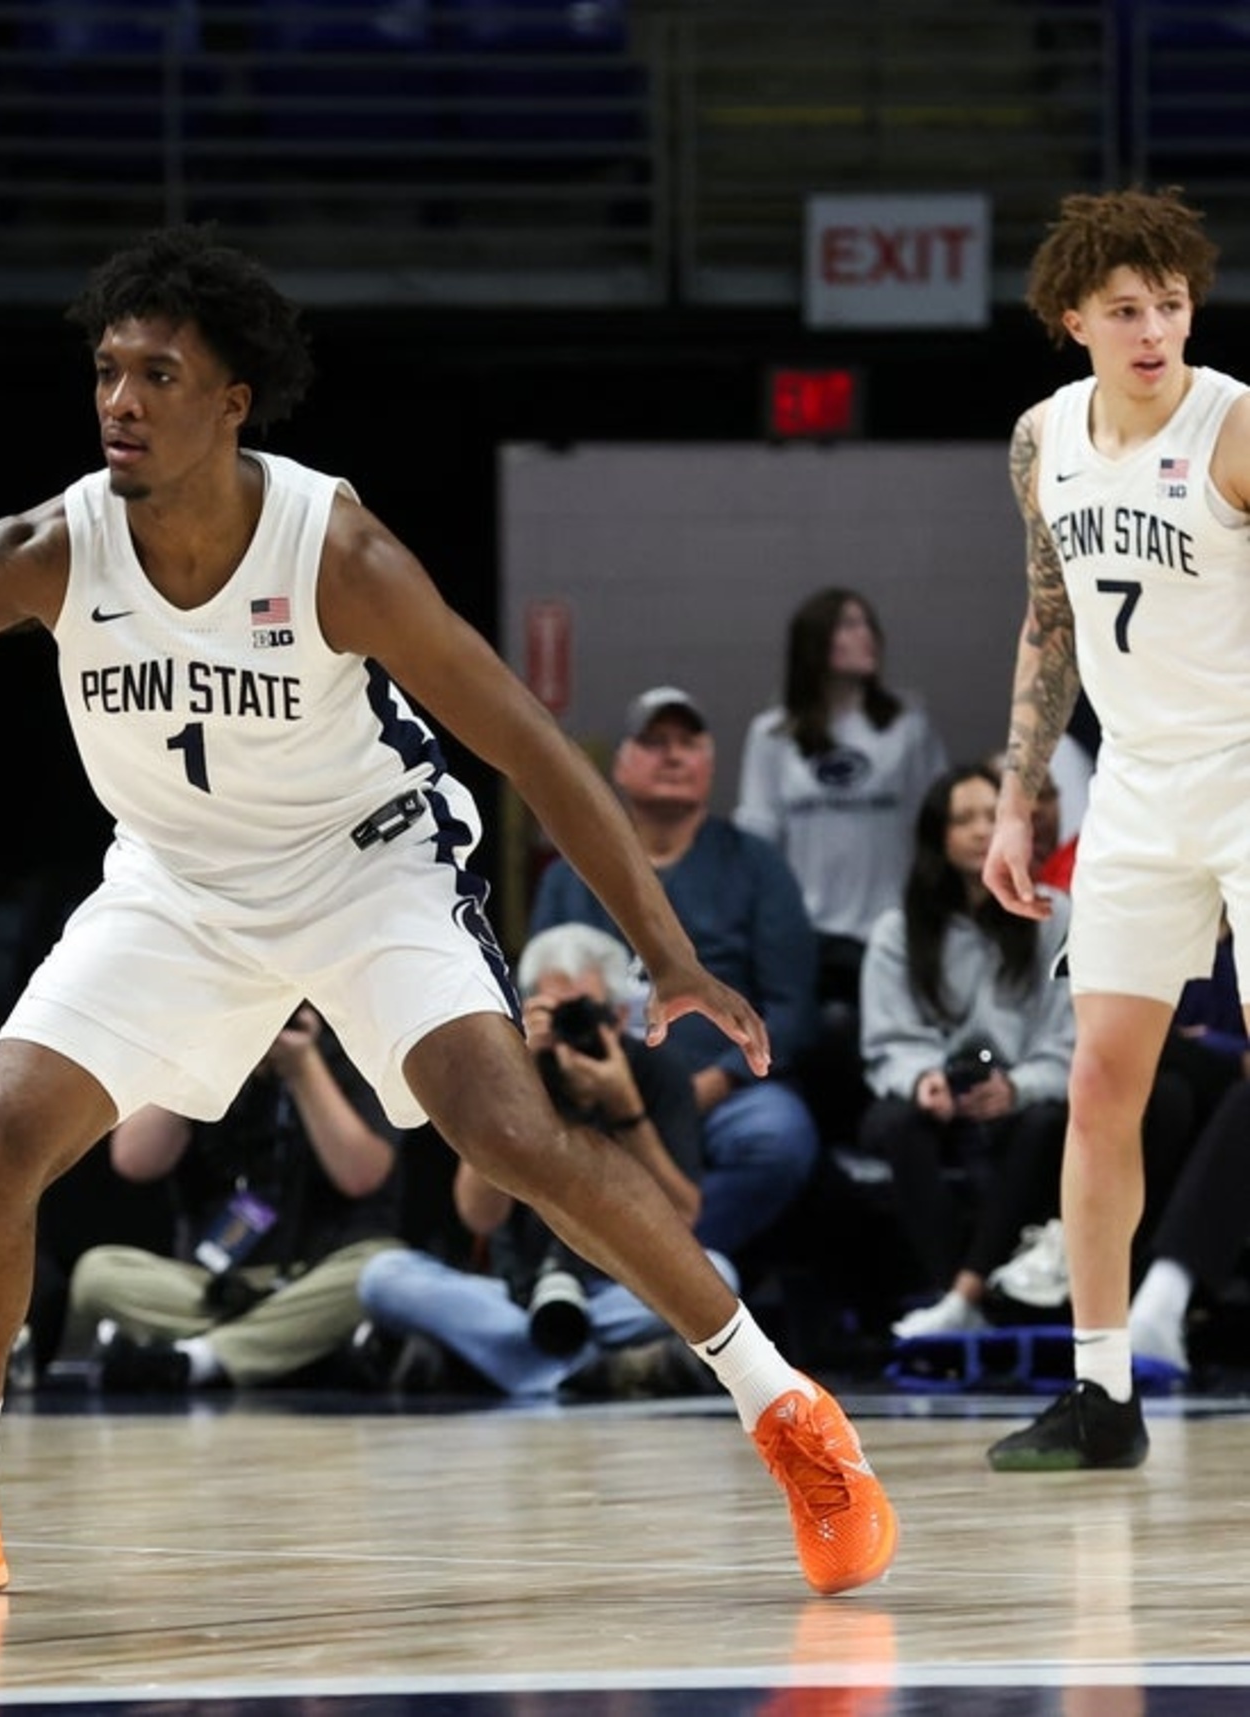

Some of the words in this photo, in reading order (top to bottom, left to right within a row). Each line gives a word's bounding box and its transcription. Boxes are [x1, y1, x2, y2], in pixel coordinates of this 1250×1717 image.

[821, 226, 971, 286] EXIT
[1114, 507, 1199, 577] STATE
[1096, 578, 1142, 653] 7
[81, 657, 174, 713] PENN
[188, 661, 303, 720] STATE
[166, 722, 210, 793] 1
